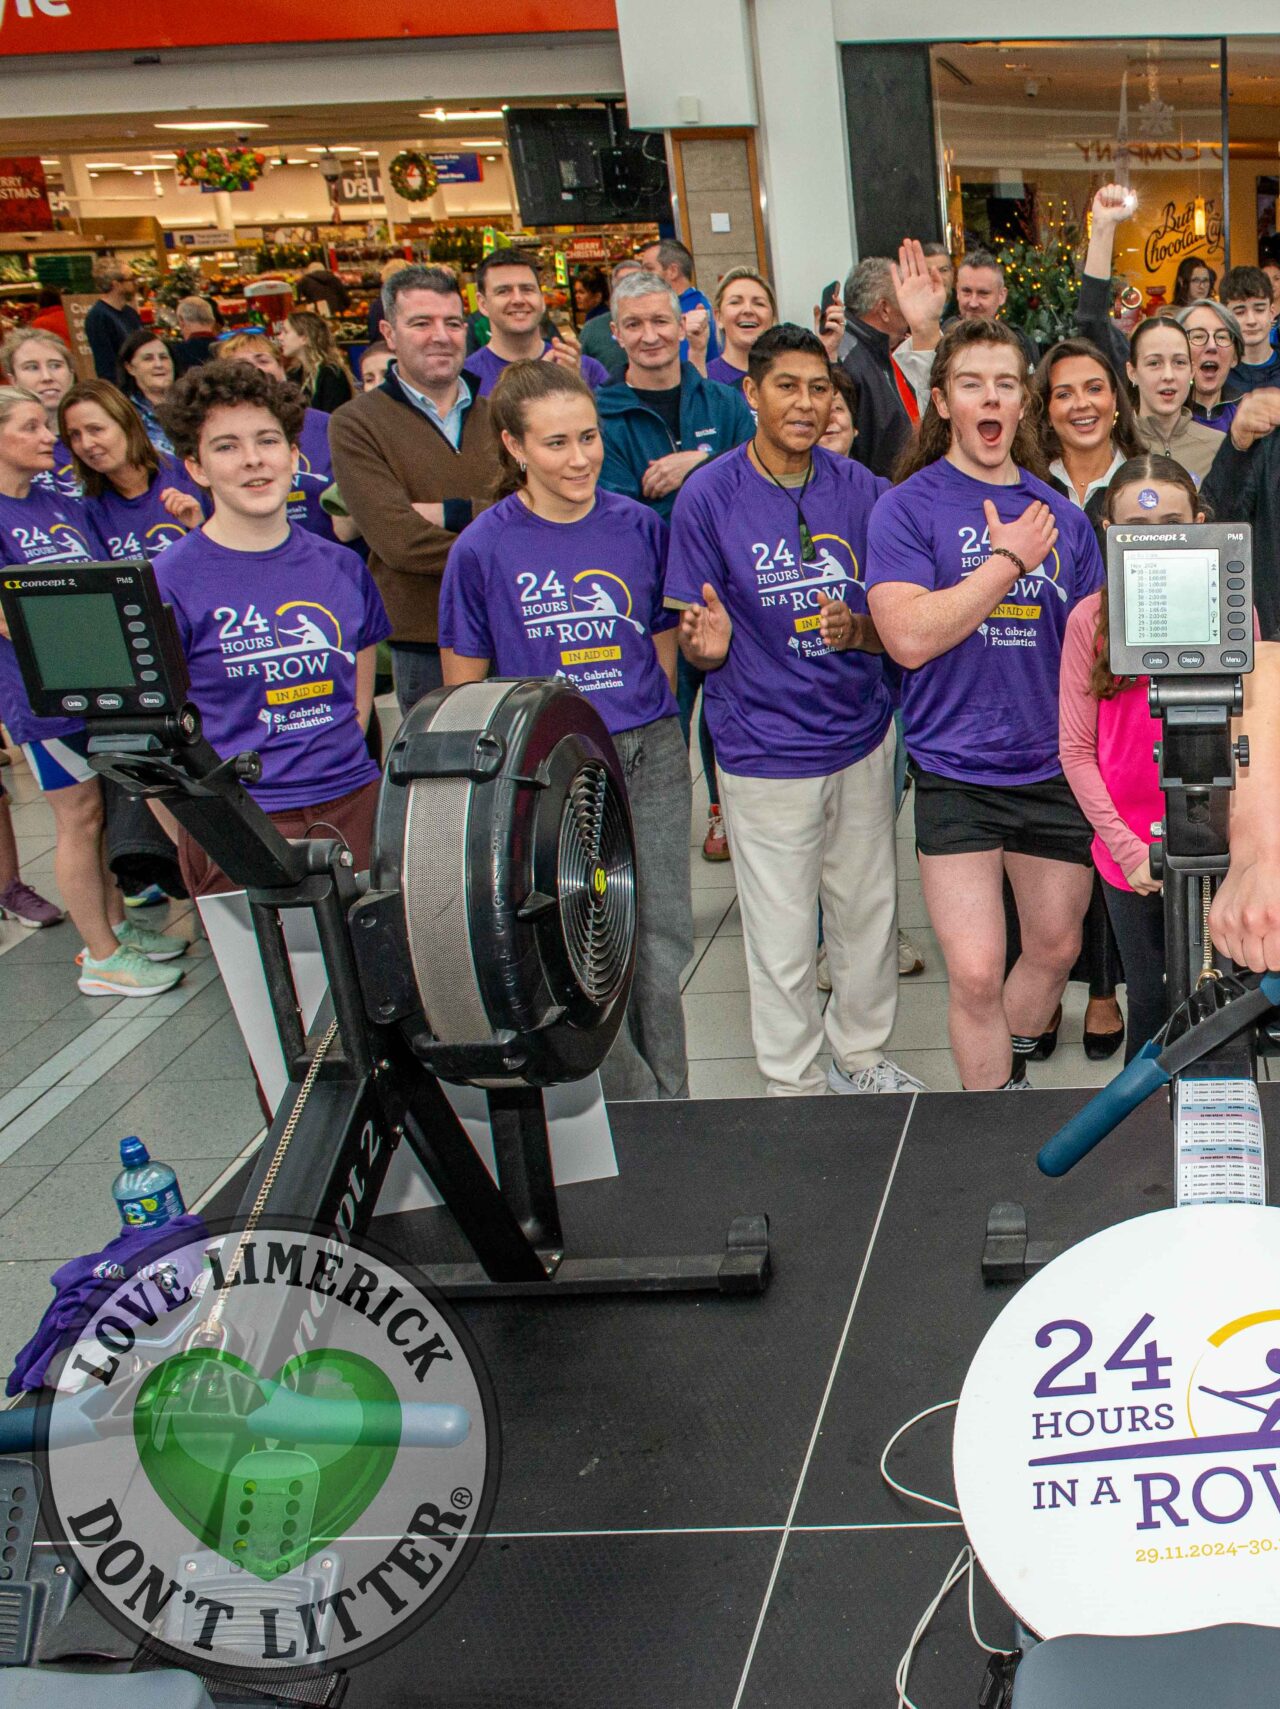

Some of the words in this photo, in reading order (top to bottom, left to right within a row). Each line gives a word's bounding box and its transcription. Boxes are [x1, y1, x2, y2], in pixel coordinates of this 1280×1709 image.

[573, 241, 601, 250] MERRY
[1145, 224, 1207, 273] Chocola
[565, 249, 610, 259] CHRISTMAS
[11, 526, 52, 549] 24
[108, 532, 142, 558] 24
[1132, 533, 1178, 542] concept
[1227, 533, 1244, 541] PM5
[23, 545, 57, 559] HOURS
[751, 538, 795, 571] 24
[21, 578, 67, 589] concept
[116, 576, 134, 585] PM5
[756, 569, 800, 585] HOURS
[516, 569, 566, 603] 24
[521, 600, 569, 617] HOURS
[760, 596, 776, 607] IN
[778, 594, 789, 605] A
[1007, 608, 1024, 616] AID
[213, 604, 270, 640] 24
[526, 628, 542, 639] IN
[544, 625, 556, 637] A
[556, 619, 617, 644] ROW
[219, 635, 275, 655] HOURS
[991, 637, 1037, 647] Foundation
[568, 653, 581, 662] IN
[583, 650, 600, 660] AID
[602, 649, 616, 658] OF
[1181, 656, 1201, 665] Display
[225, 665, 244, 678] IN
[247, 663, 260, 676] A
[262, 652, 330, 683] ROW
[584, 668, 623, 681] Gabriel's
[275, 691, 290, 702] IN
[292, 687, 310, 699] AID
[312, 683, 328, 694] OF
[575, 679, 624, 693] oundation
[67, 700, 83, 708] Units
[99, 698, 119, 706] Display
[143, 697, 160, 705] Menu
[273, 713, 288, 724] St.
[289, 703, 332, 720] Gabriel's
[276, 715, 334, 734] Foundation
[1032, 1312, 1174, 1399] 24
[1031, 1402, 1176, 1440] HOURS
[1032, 1477, 1080, 1511] IN
[1090, 1475, 1122, 1507] A
